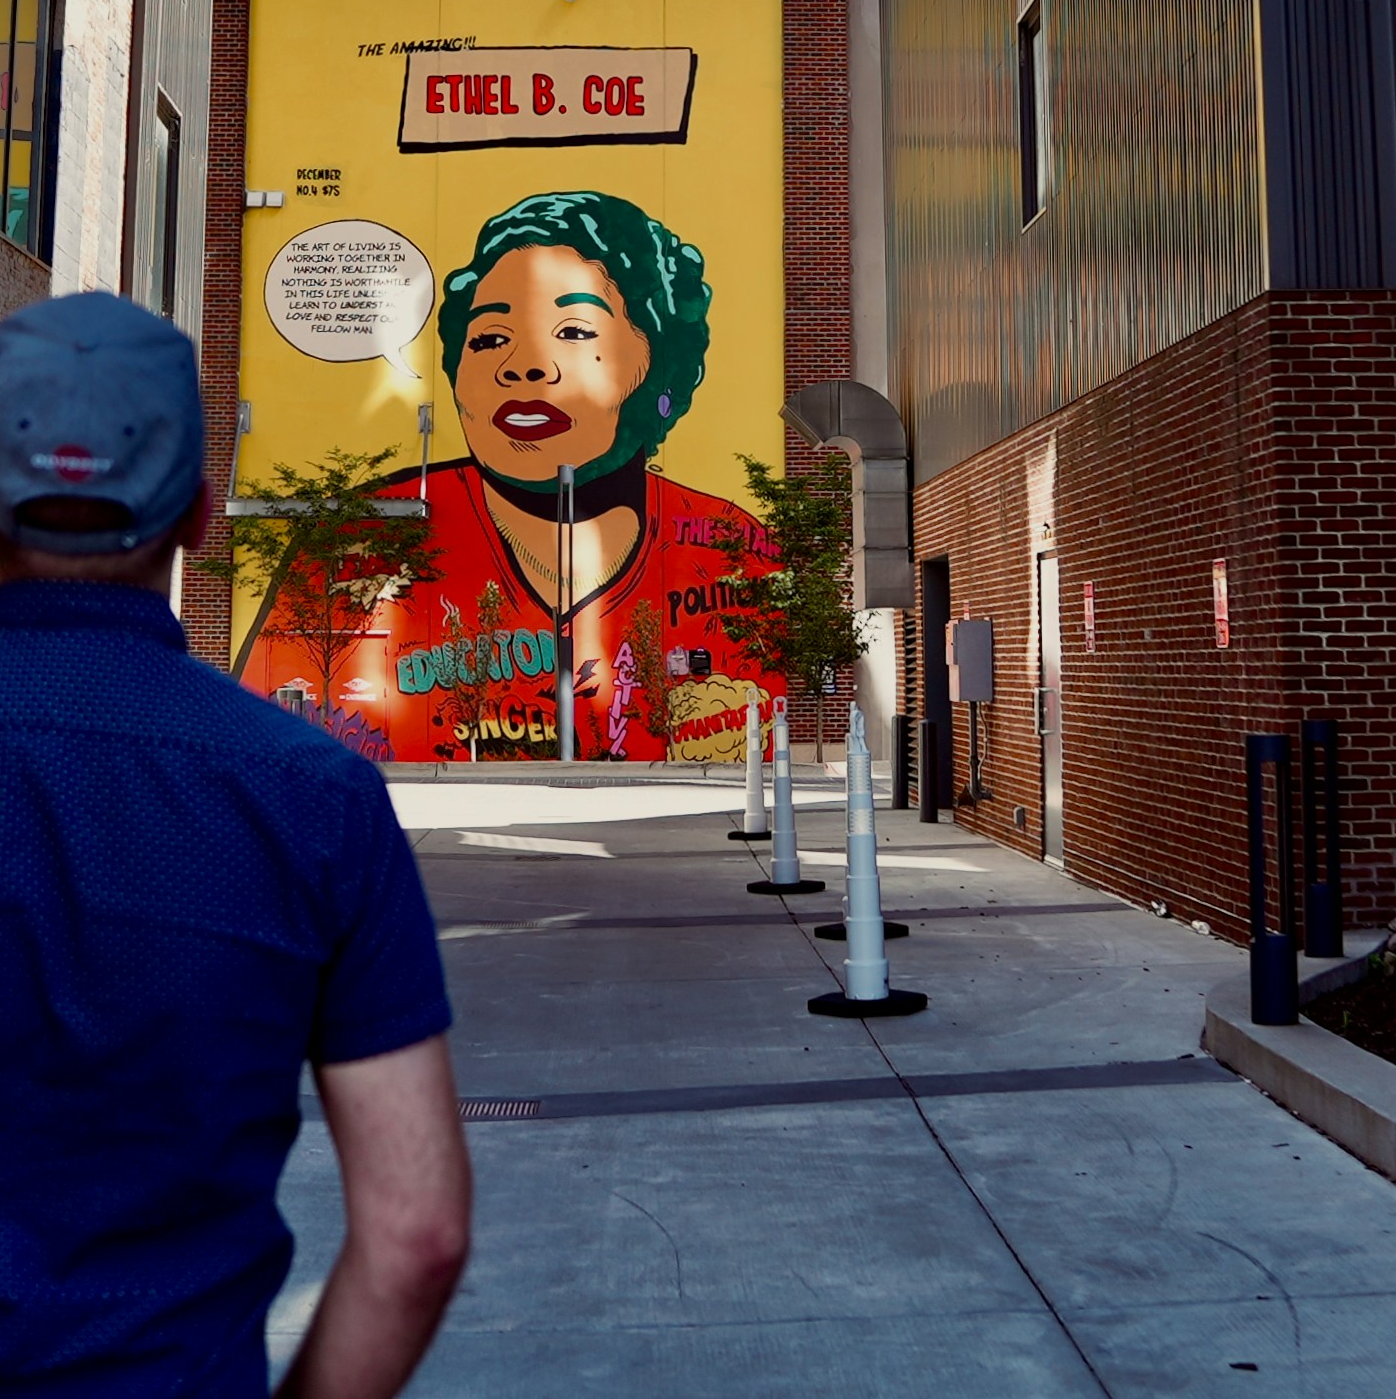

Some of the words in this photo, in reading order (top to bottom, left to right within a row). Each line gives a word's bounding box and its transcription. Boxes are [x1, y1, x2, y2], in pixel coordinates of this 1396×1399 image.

[357, 43, 386, 57] THE
[390, 36, 476, 55] AMAZING!!!
[426, 74, 519, 115] ETHEL
[532, 73, 567, 116] B.
[582, 74, 645, 116] COE
[296, 169, 341, 180] DECEMBER
[296, 185, 317, 196] NO.4
[291, 243, 308, 251] THE
[312, 243, 329, 251] ART
[333, 243, 345, 251] OF
[349, 243, 386, 251] LIVING
[389, 242, 401, 251] IS
[286, 254, 335, 263] WORKING
[339, 254, 390, 262] TOGETHER
[393, 254, 405, 262] IN
[342, 265, 397, 274] REALIZING
[282, 278, 327, 287] NOTHING
[330, 278, 342, 287] IS
[285, 290, 297, 298] IN
[300, 290, 324, 298] THIS
[327, 290, 350, 298] LIFE
[353, 290, 387, 298] UNLES
[289, 301, 320, 310] LEARN
[323, 301, 337, 310] TO
[286, 312, 313, 320] LOVE
[335, 314, 377, 323] RESPECT
[311, 325, 352, 333] FELLOW
